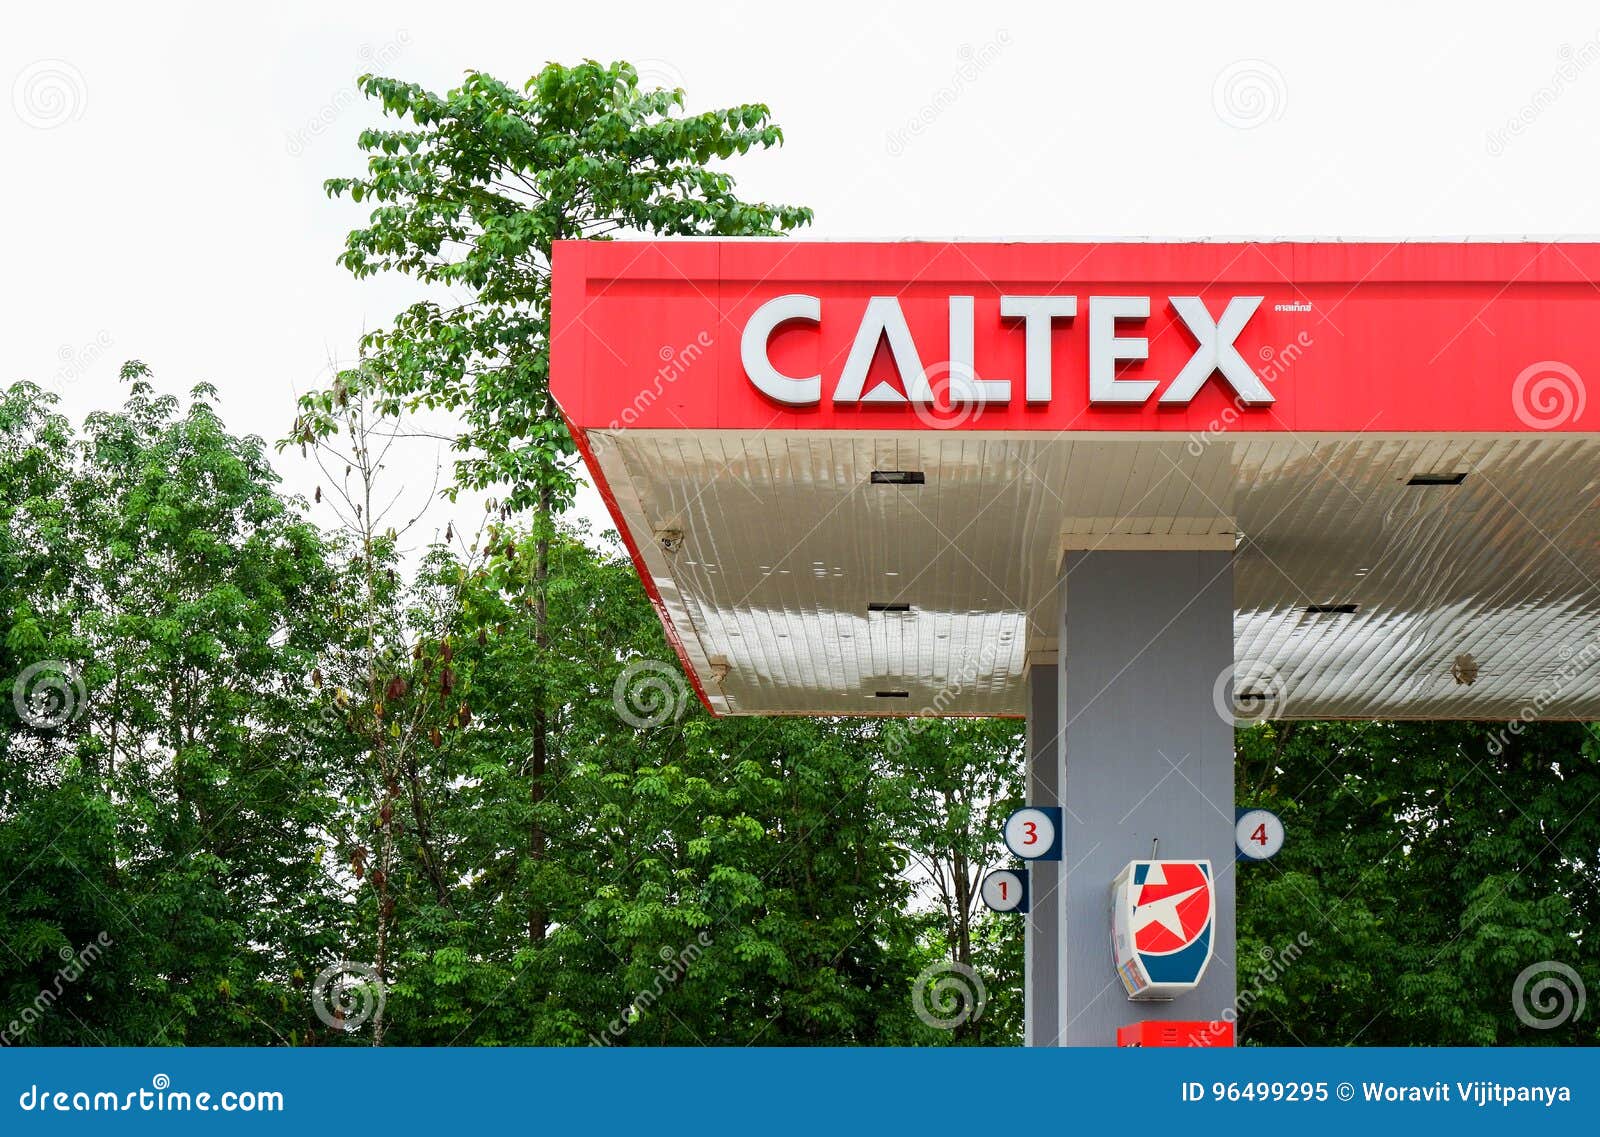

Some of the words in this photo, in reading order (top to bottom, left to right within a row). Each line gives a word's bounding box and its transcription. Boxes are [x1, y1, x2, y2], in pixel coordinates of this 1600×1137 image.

[741, 295, 1275, 405] CALTEX
[1023, 821, 1038, 845] 3
[1251, 824, 1268, 846] 4
[998, 881, 1008, 901] 1
